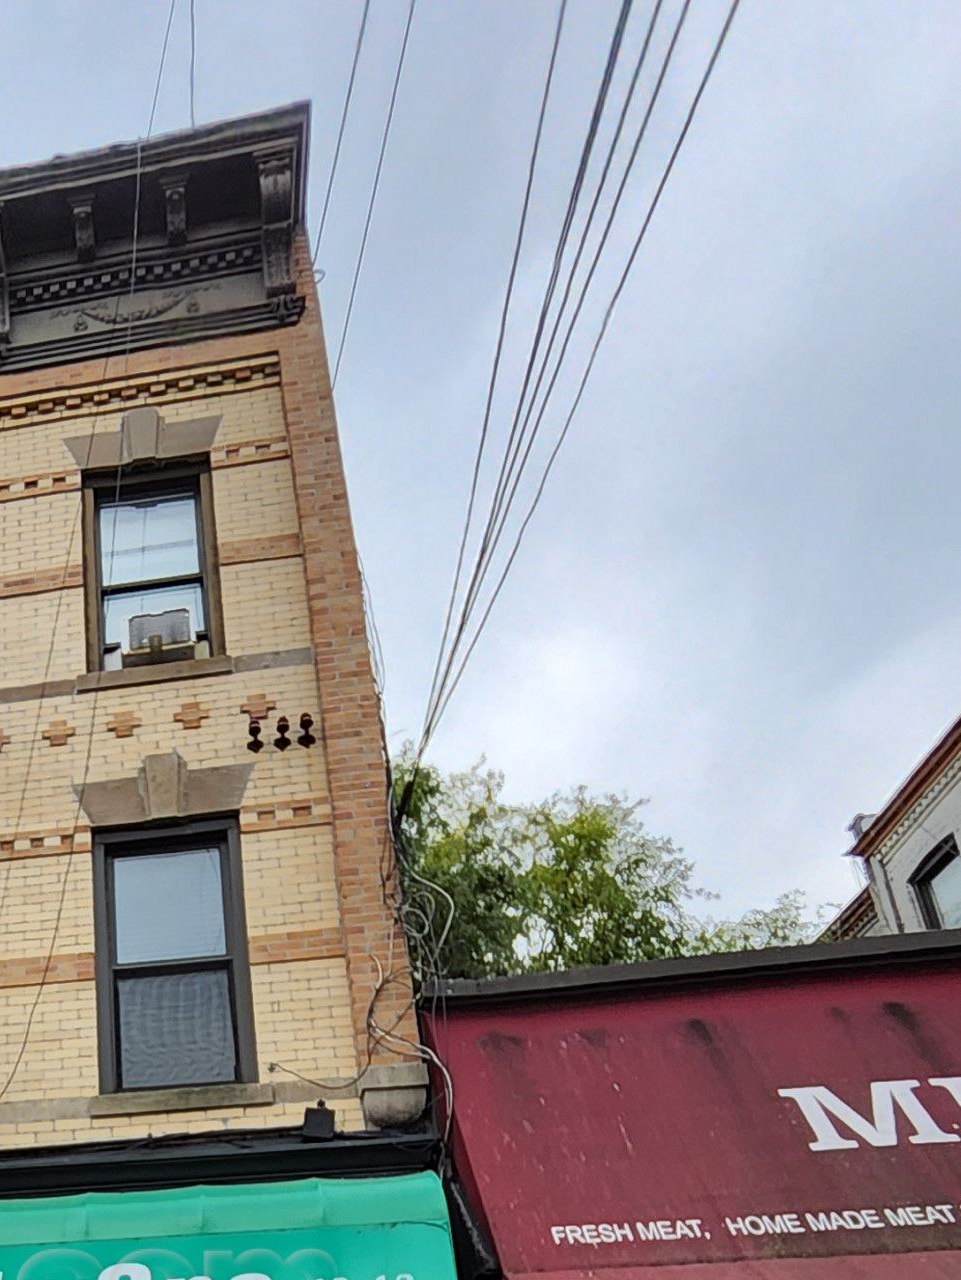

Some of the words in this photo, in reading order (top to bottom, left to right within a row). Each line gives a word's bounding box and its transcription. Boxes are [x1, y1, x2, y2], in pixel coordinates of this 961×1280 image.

[551, 1222, 634, 1246] FRESH
[636, 1218, 711, 1241] MEAT,
[725, 1213, 806, 1237] HOME
[804, 1208, 886, 1233] MADE
[887, 1203, 956, 1228] MEAT
